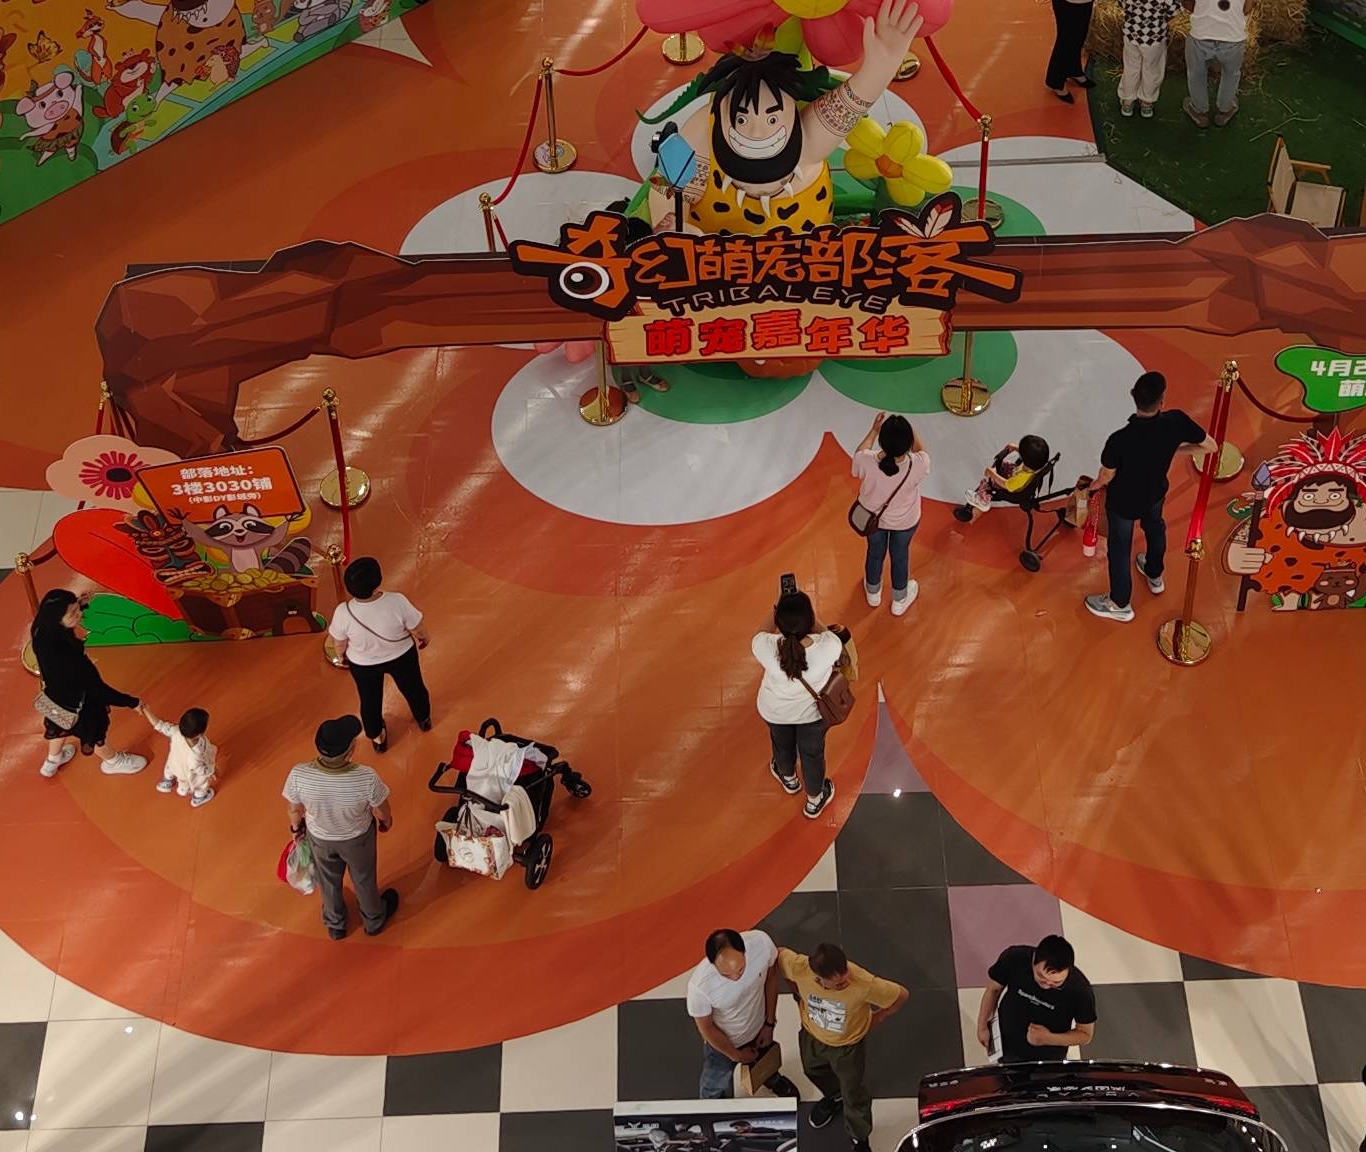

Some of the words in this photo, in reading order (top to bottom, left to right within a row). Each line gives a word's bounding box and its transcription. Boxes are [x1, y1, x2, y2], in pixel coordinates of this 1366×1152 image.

[515, 225, 1017, 309] 奇幻萌宠部落
[645, 309, 910, 356] 萌宠嘉年华
[170, 476, 273, 496] 3楼3030铺
